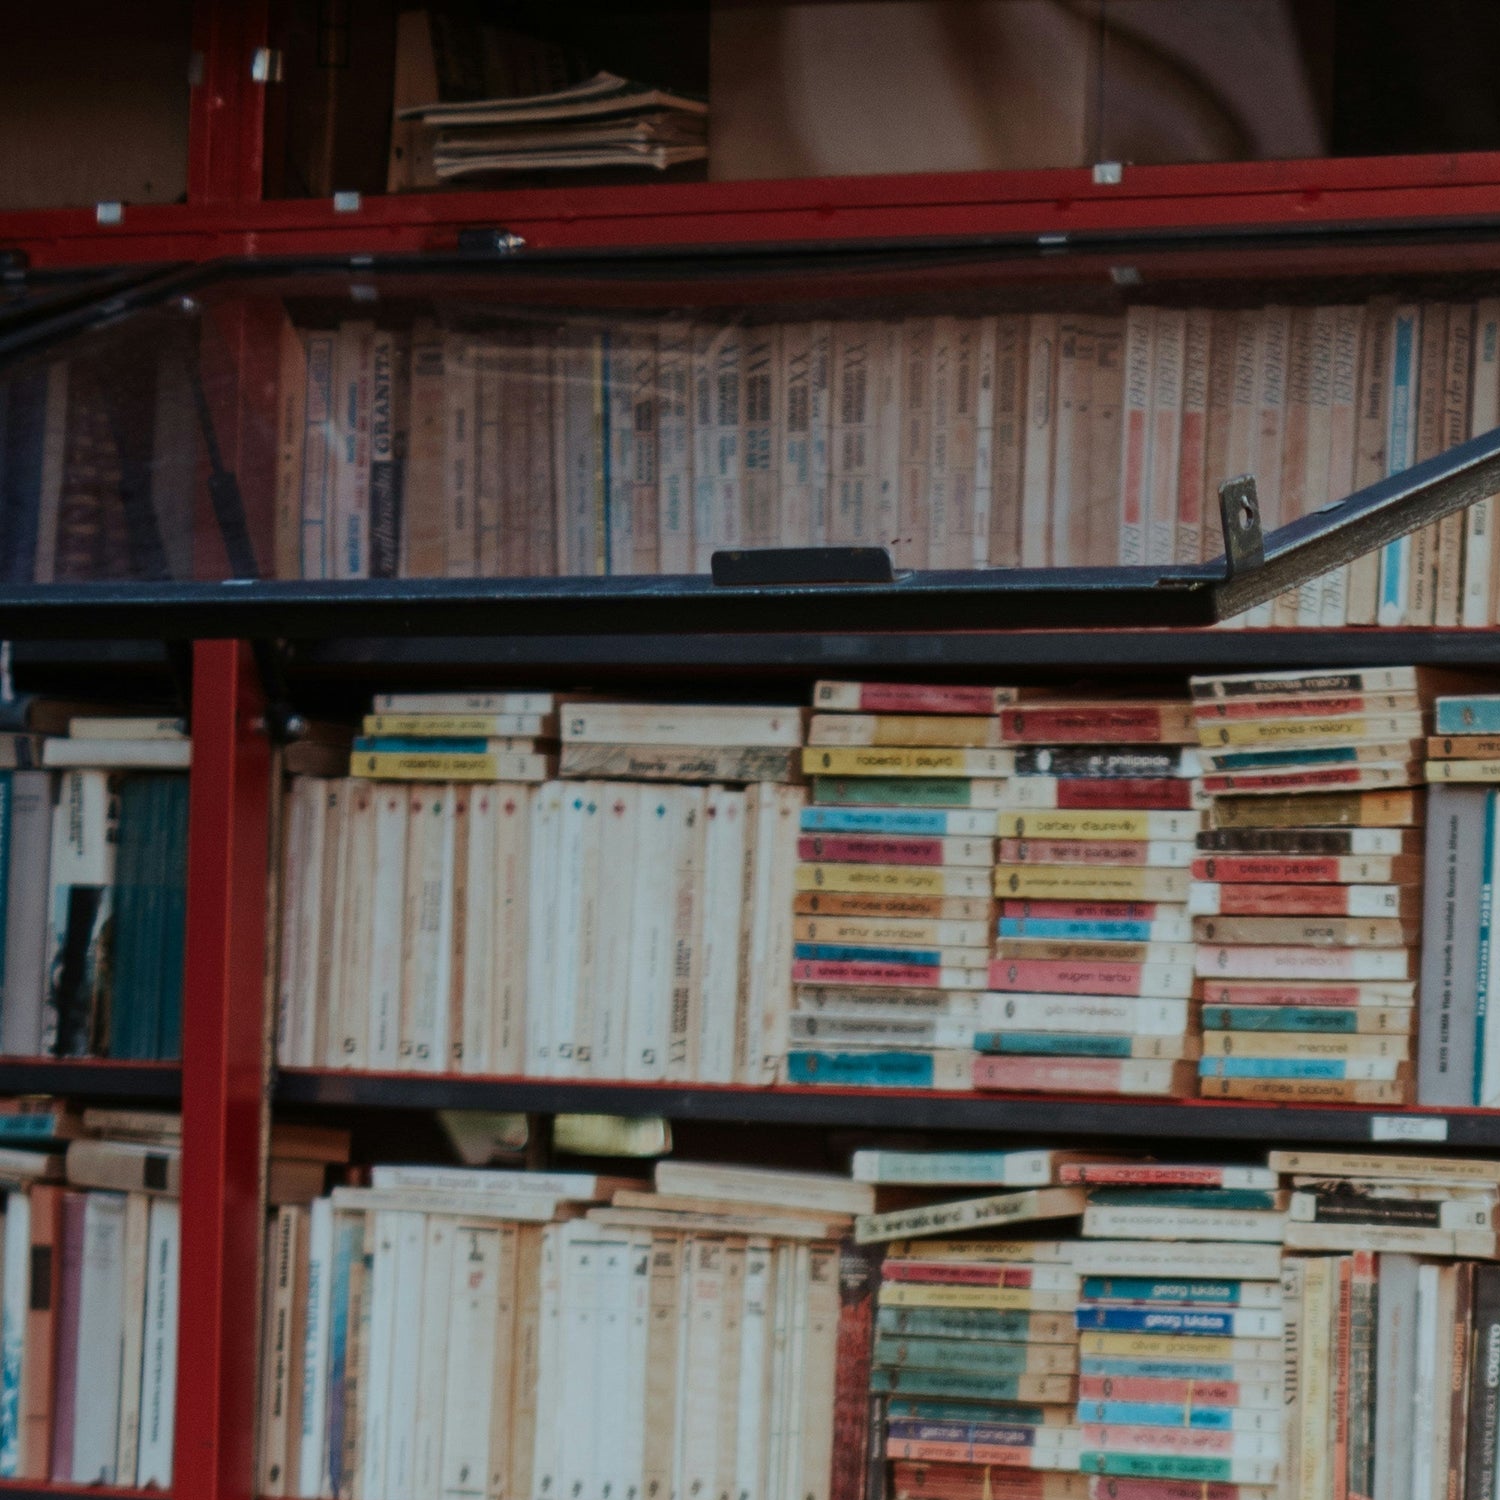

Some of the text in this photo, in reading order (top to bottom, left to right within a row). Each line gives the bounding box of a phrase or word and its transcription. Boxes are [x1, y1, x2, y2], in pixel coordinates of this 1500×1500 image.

[1255, 677, 1348, 691] thomas malory
[1259, 723, 1352, 736] thomas malory
[857, 756, 901, 765] roberto
[1109, 754, 1169, 767] philippide
[1037, 821, 1075, 832] barbey
[903, 844, 930, 855] vigny
[1240, 864, 1326, 874] cesare pavese
[849, 873, 934, 886] alfred de vigny
[886, 902, 929, 912] ciobanu
[1481, 883, 1491, 926] POEME
[838, 927, 869, 936] arthur
[1303, 927, 1334, 937] lorca
[1058, 971, 1131, 985] eugen barbu
[1253, 1084, 1343, 1095] mircea ciobanu
[1153, 1284, 1187, 1296] georg
[1145, 1314, 1181, 1327] georg
[1132, 1341, 1218, 1352] oliver goldsmith
[1284, 1321, 1297, 1405] STILETUL
[1167, 1489, 1227, 1499] maugam
